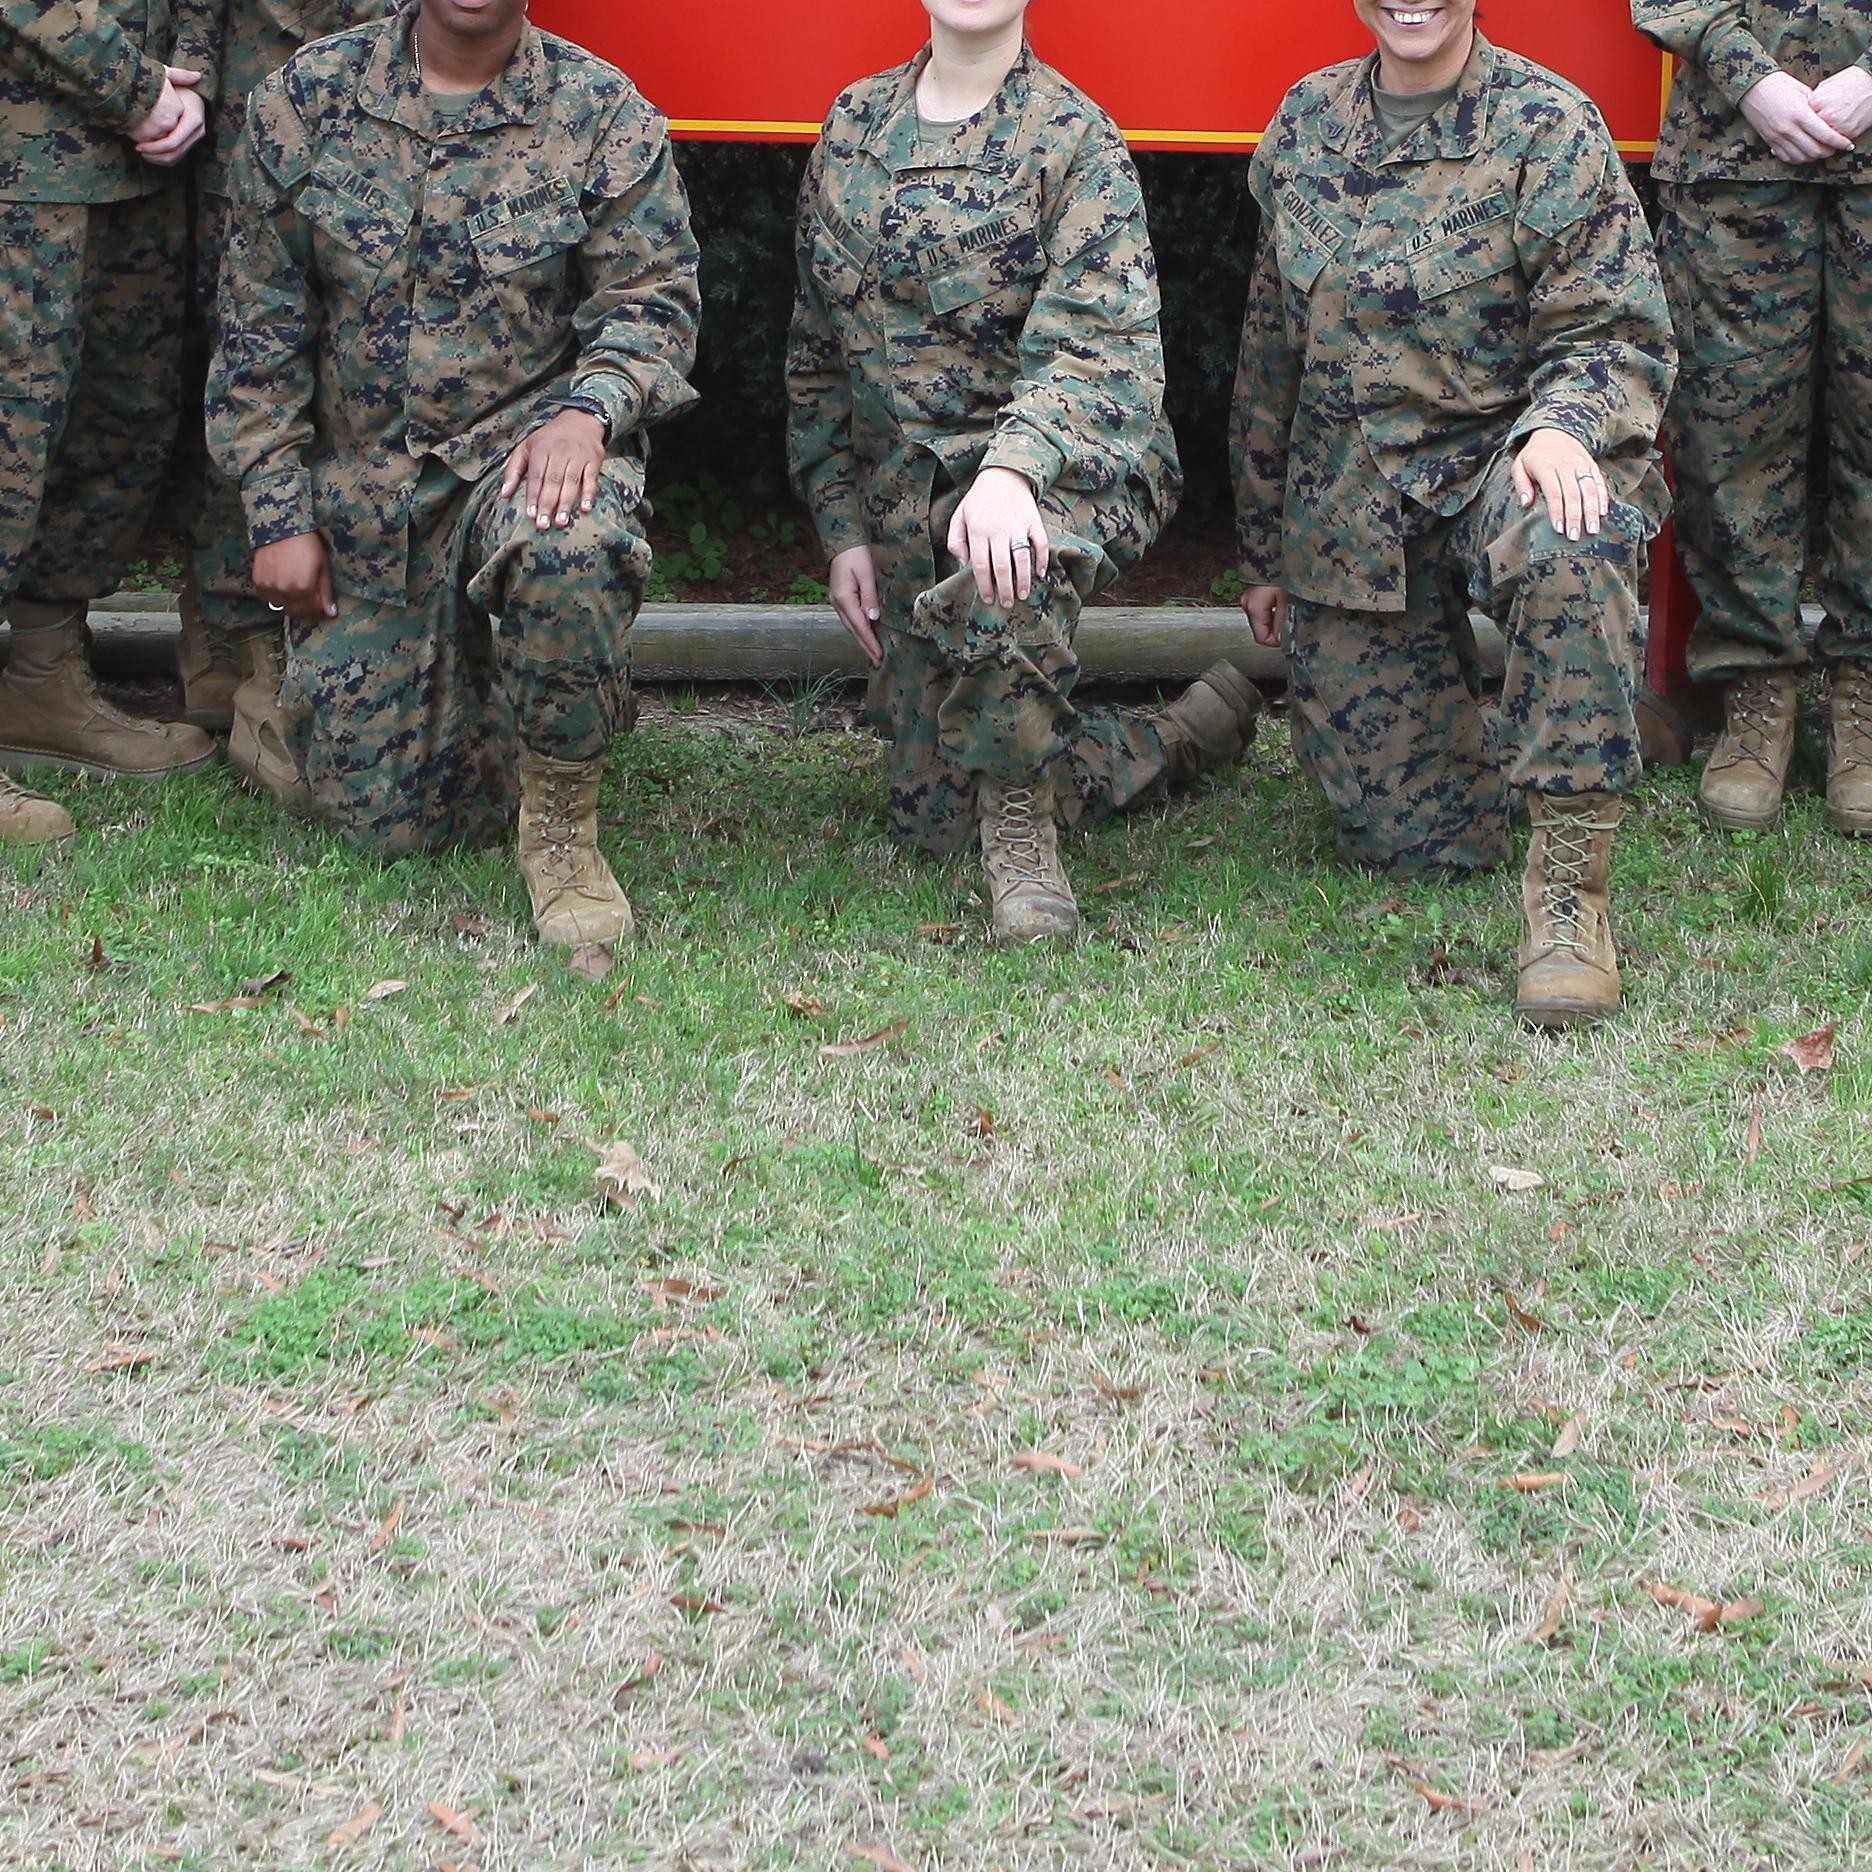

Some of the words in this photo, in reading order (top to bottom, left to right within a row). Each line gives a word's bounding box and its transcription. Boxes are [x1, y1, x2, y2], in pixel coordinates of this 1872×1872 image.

[337, 168, 390, 211] JAMES
[506, 179, 566, 220] MARINES
[956, 215, 1020, 254] MARINES
[1282, 190, 1340, 246] GONZALEZ
[1441, 197, 1504, 236] MARINES
